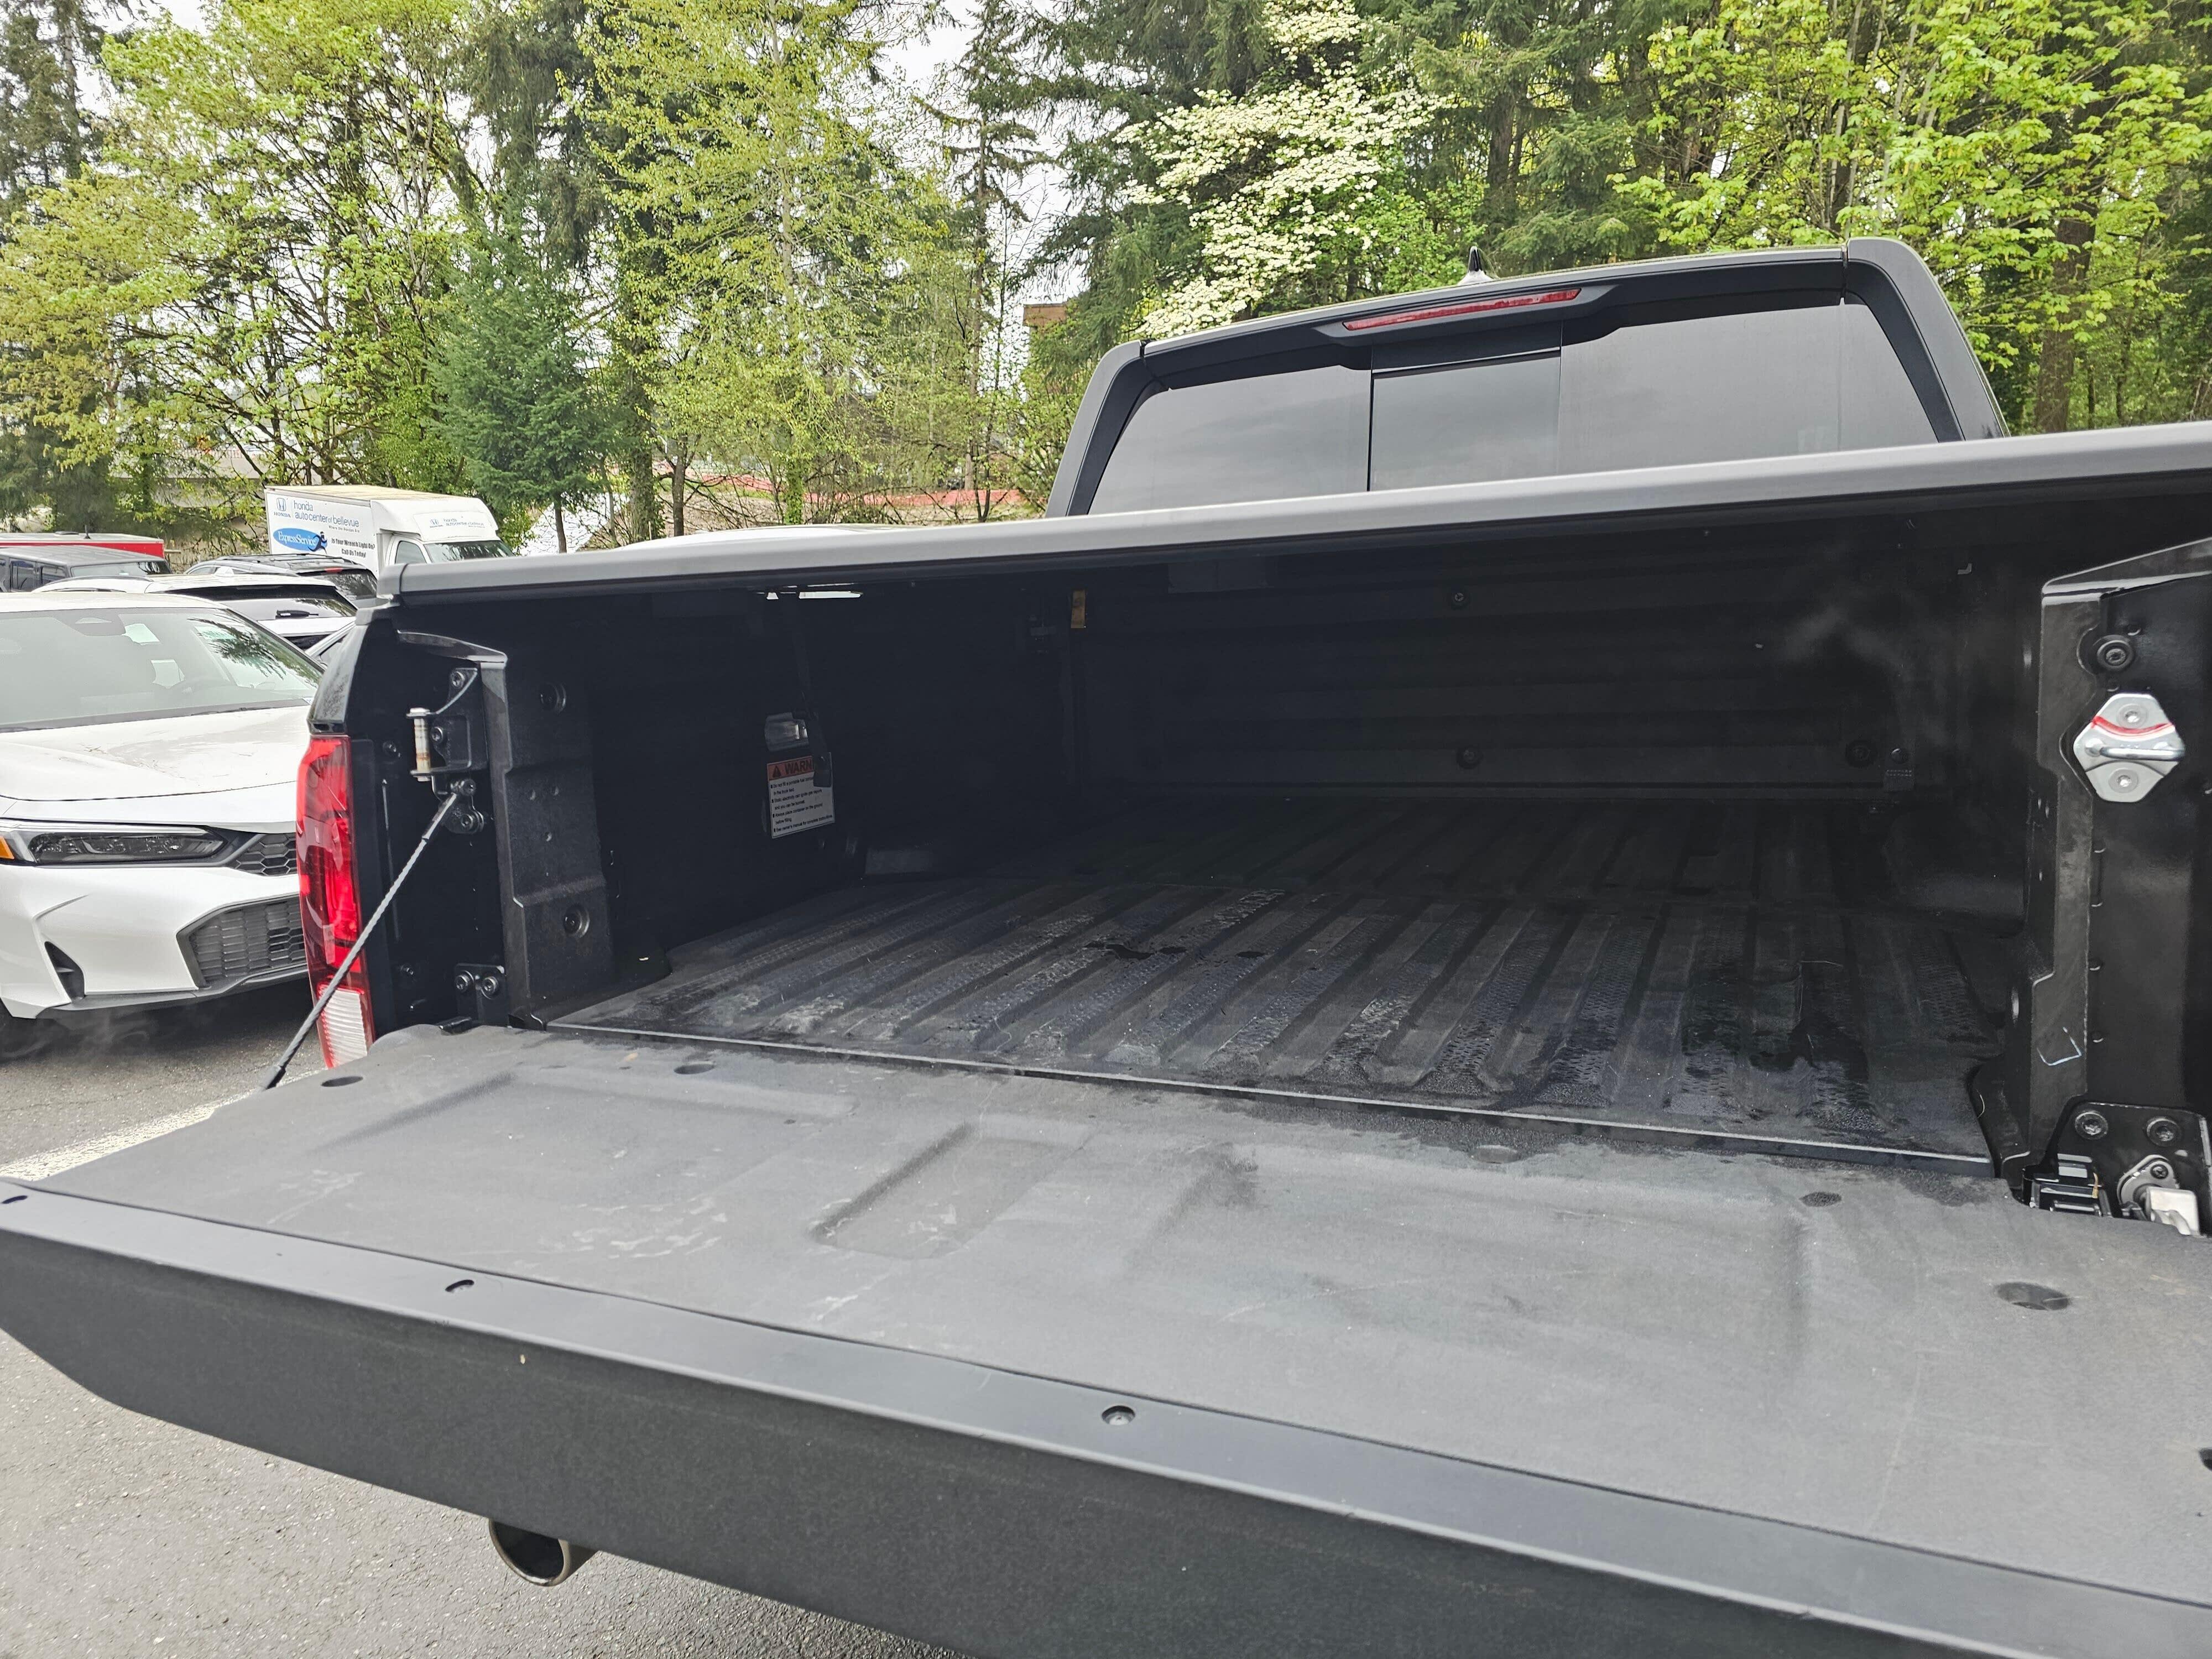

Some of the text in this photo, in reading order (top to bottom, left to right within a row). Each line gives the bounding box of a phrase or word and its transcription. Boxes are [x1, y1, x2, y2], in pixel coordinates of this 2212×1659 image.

[294, 500, 314, 512] honda
[333, 515, 359, 527] bellevue
[785, 758, 813, 774] WARN
